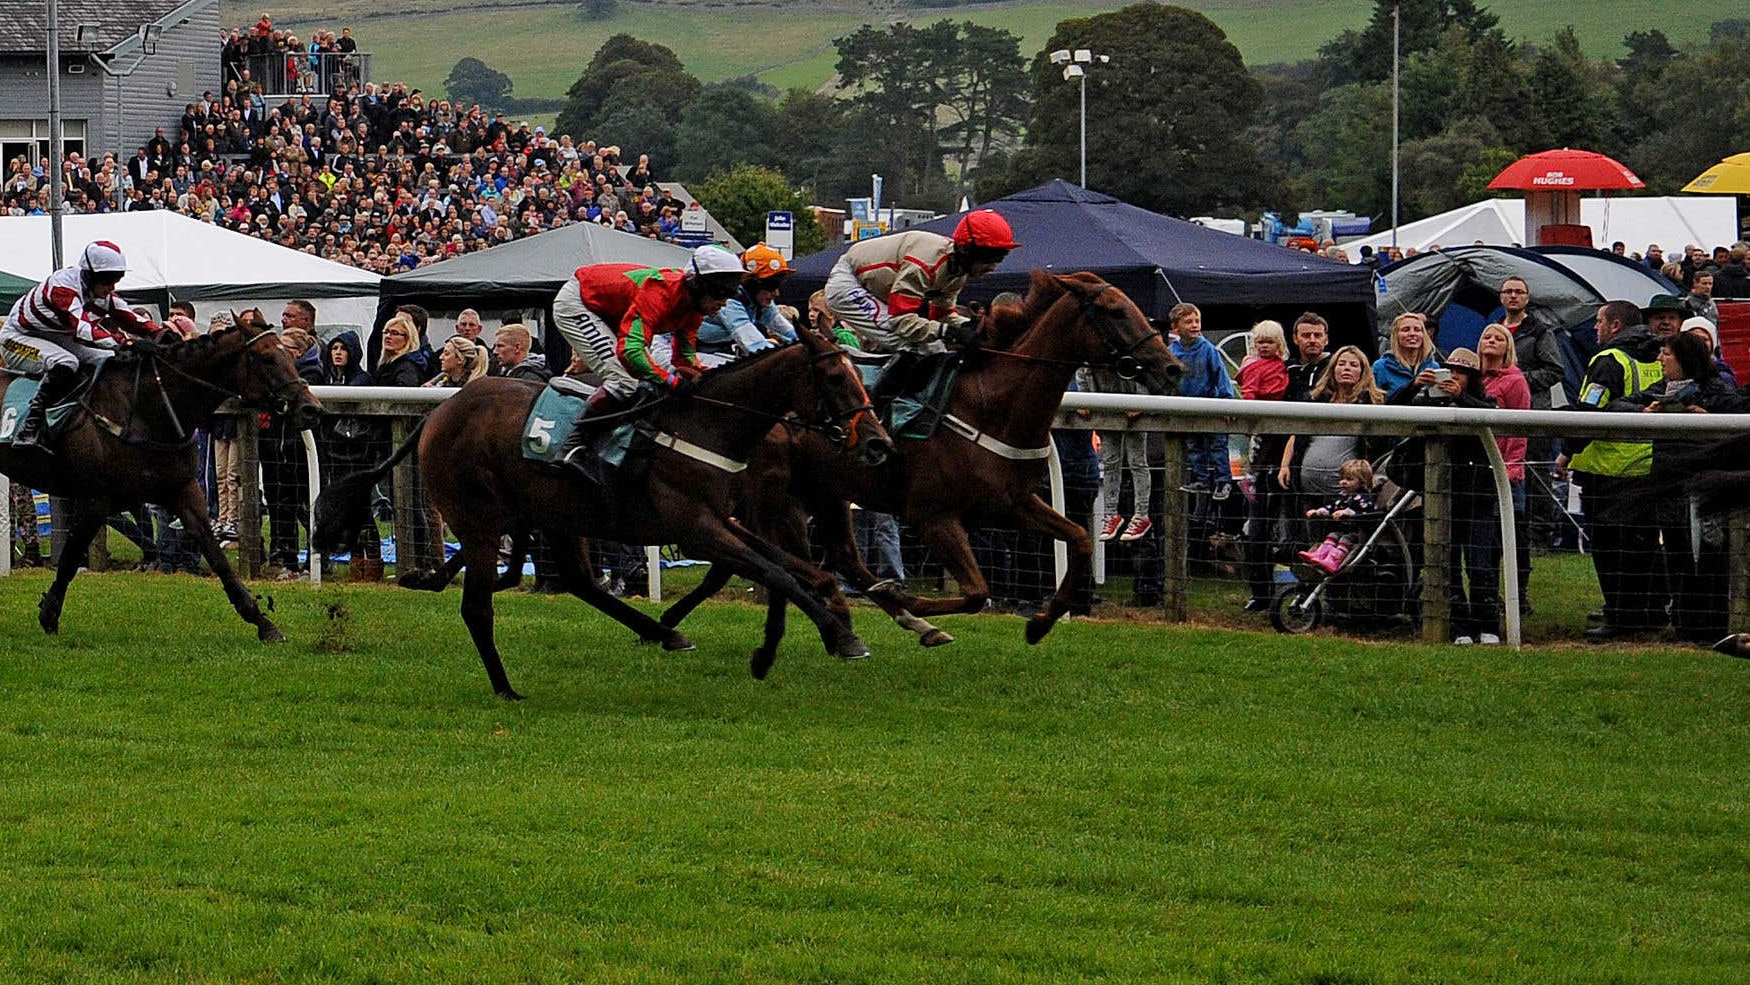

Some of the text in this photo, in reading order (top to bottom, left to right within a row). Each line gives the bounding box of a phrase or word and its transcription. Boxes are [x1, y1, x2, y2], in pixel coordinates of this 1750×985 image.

[1533, 177, 1575, 185] HUGHES
[575, 313, 616, 361] Amlin
[0, 407, 18, 439] 6
[528, 418, 556, 454] 5
